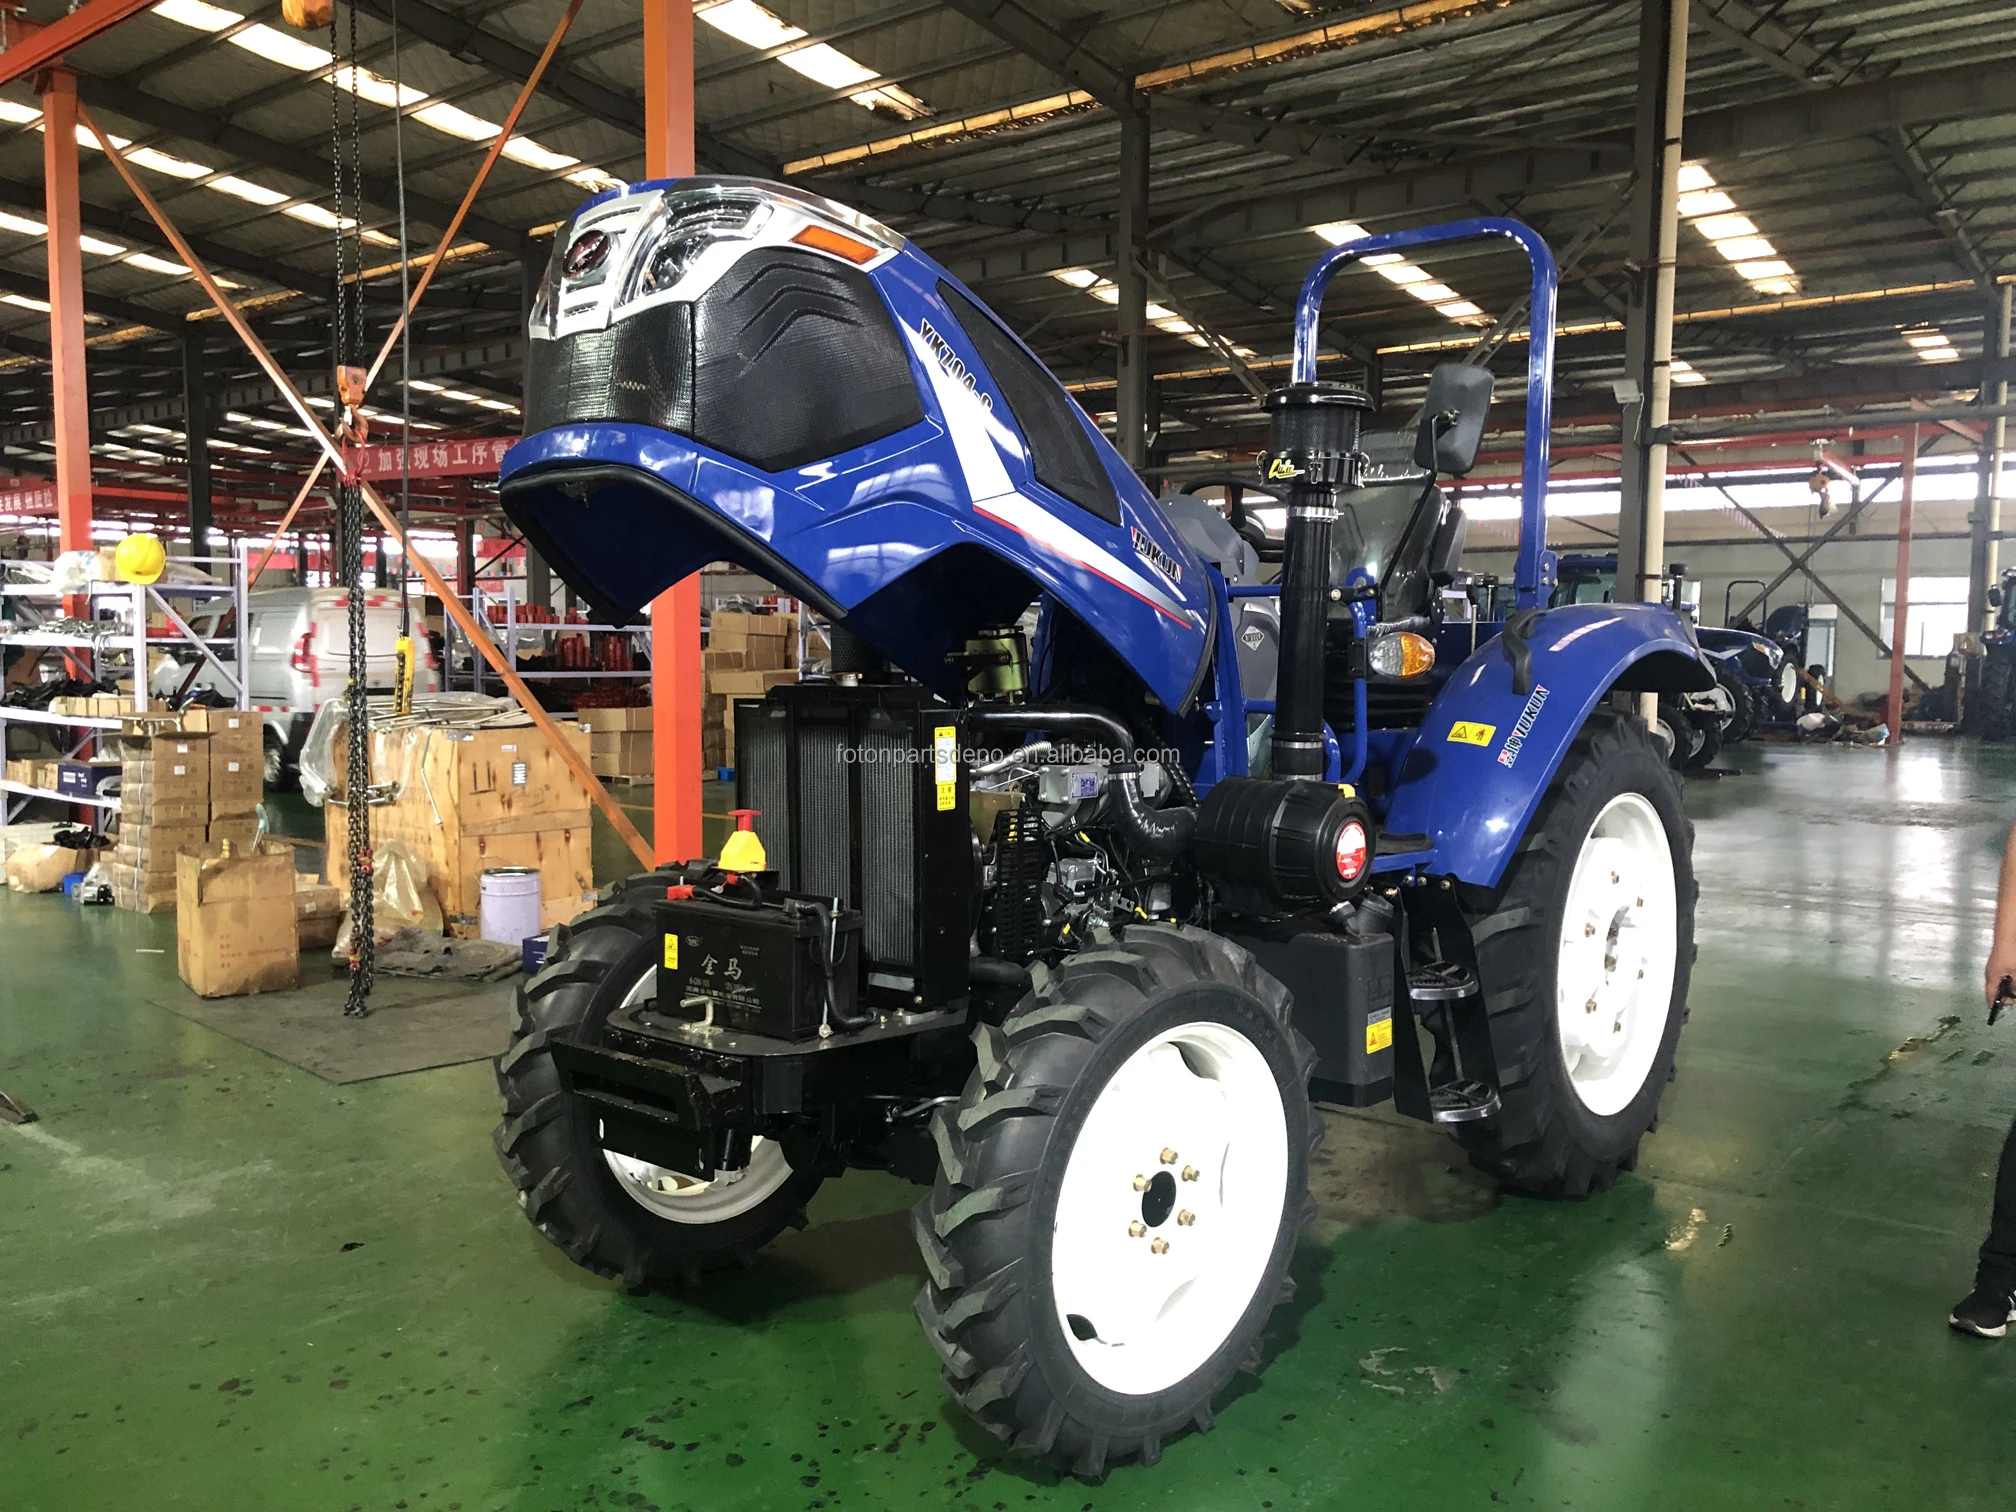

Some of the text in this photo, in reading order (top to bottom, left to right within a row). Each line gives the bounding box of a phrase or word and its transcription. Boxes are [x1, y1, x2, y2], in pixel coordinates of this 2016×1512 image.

[378, 437, 520, 472] 加强现场工序管
[1512, 684, 1550, 738] YUKUN
[701, 953, 742, 980] 金马
